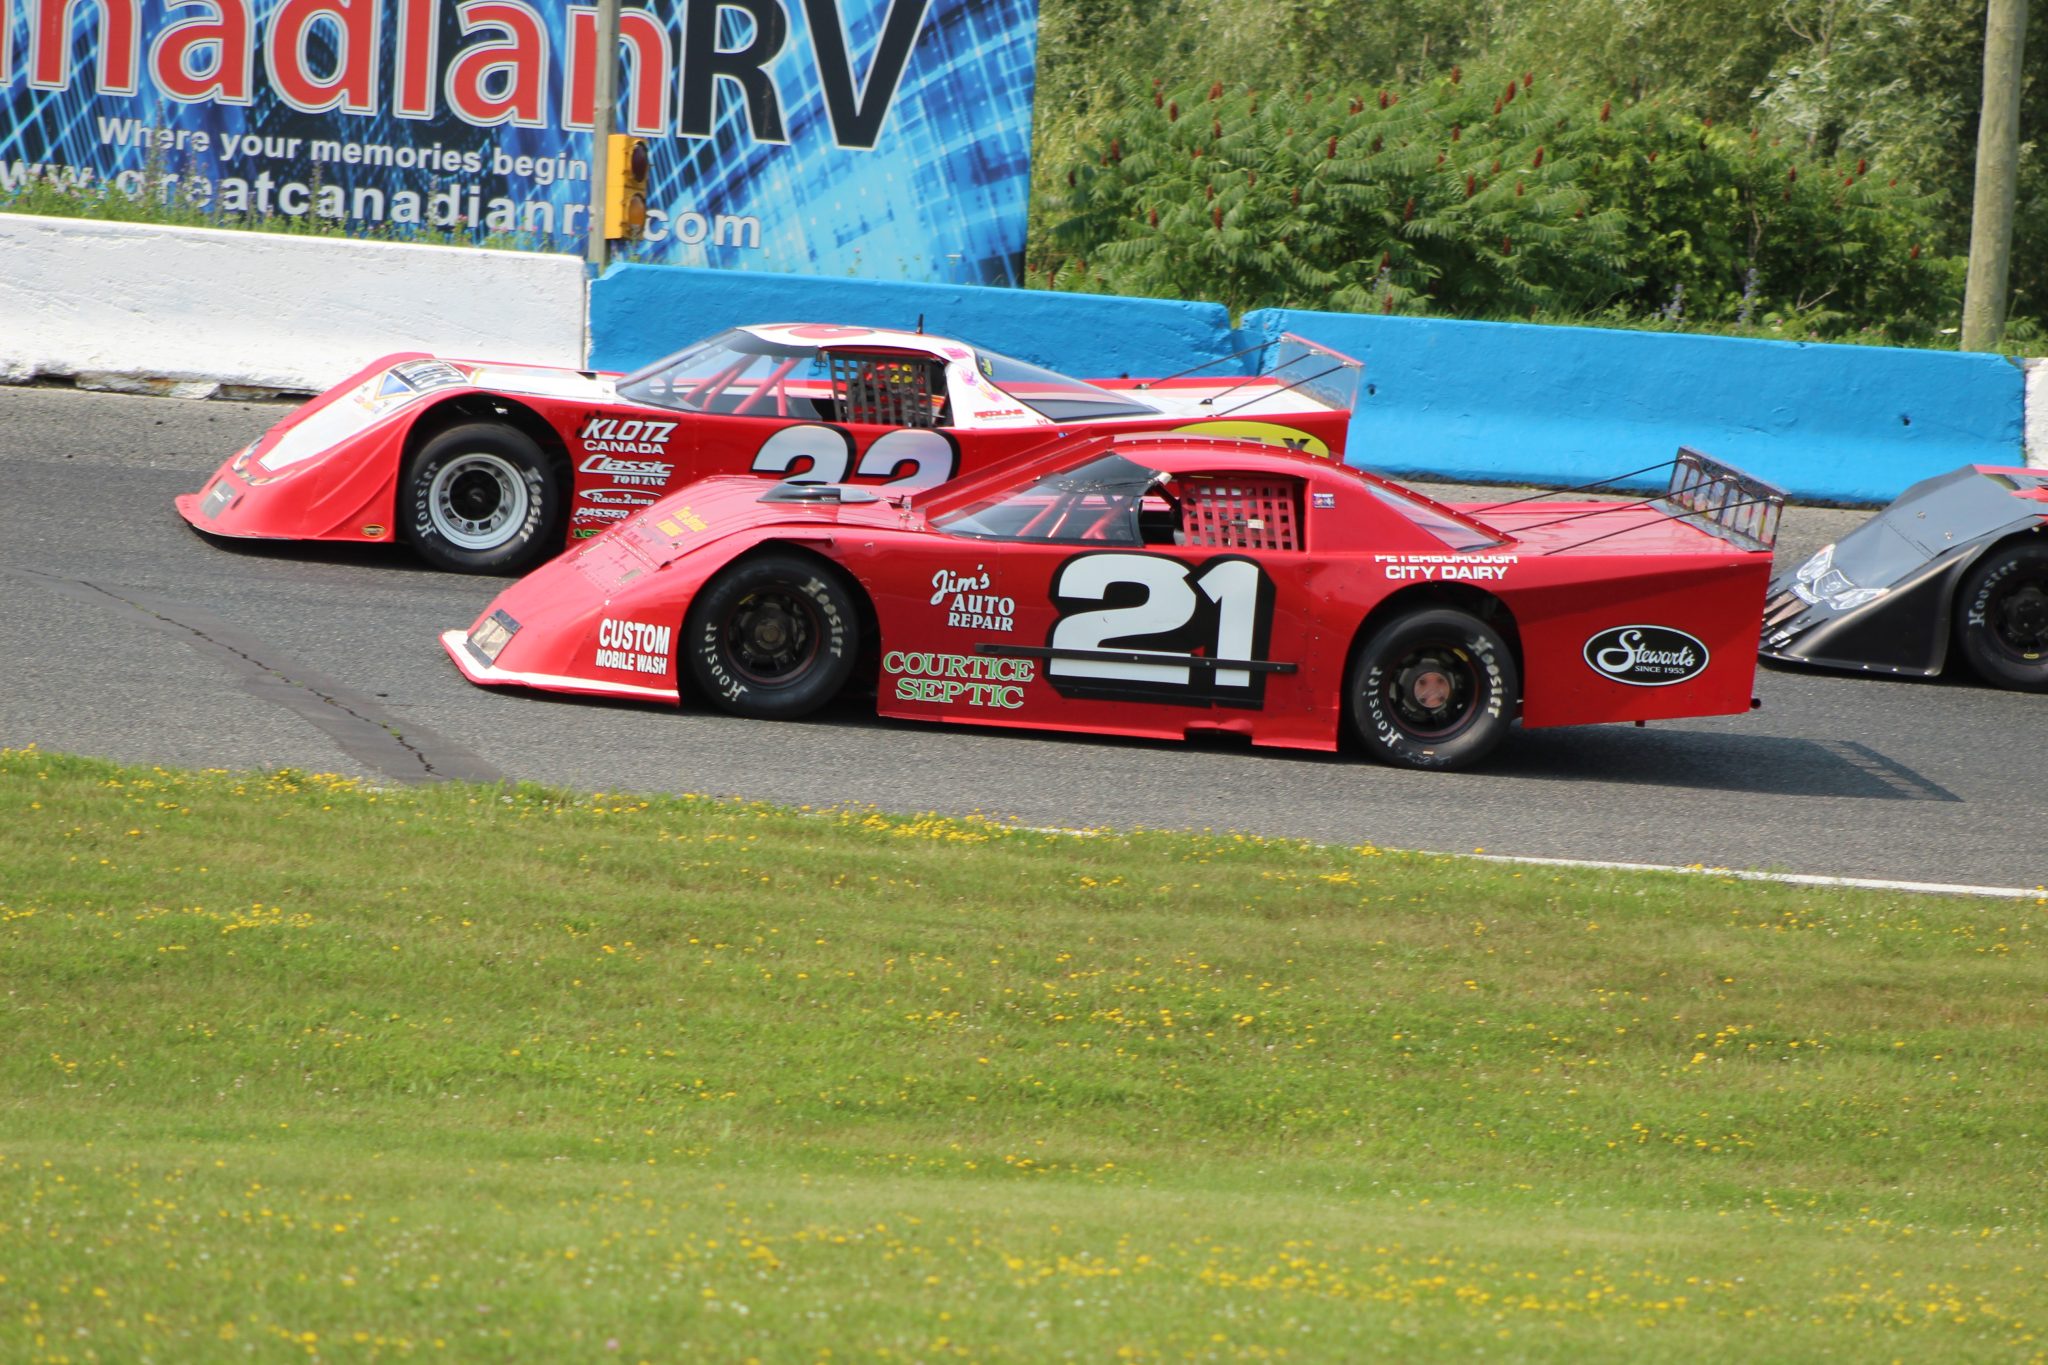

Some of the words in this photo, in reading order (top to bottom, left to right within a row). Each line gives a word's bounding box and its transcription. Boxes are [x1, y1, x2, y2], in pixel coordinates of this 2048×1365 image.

[98, 116, 210, 152] Where
[220, 133, 305, 161] your
[310, 139, 482, 173] memories
[493, 147, 588, 185] begin
[581, 418, 679, 443] KLOTZ
[583, 440, 665, 455] CANADA
[578, 454, 676, 478] Classic
[930, 563, 991, 606] Jim's
[1385, 565, 1436, 580] CITY
[1441, 565, 1509, 580] DAIRY
[950, 593, 1015, 616] AUTO
[599, 617, 671, 656] CUSTOM
[947, 612, 1014, 632] REPAIR
[1048, 552, 1262, 690] 21
[595, 648, 635, 671] MOBILE
[636, 653, 668, 675] WASH
[699, 622, 748, 701] Hoosier
[883, 651, 1035, 682] COURTICE
[1597, 629, 1696, 673] Stewart's
[1635, 665, 1661, 673] SINCE
[895, 677, 1025, 709] SEPTIC
[1362, 666, 1404, 748] Hoosier
